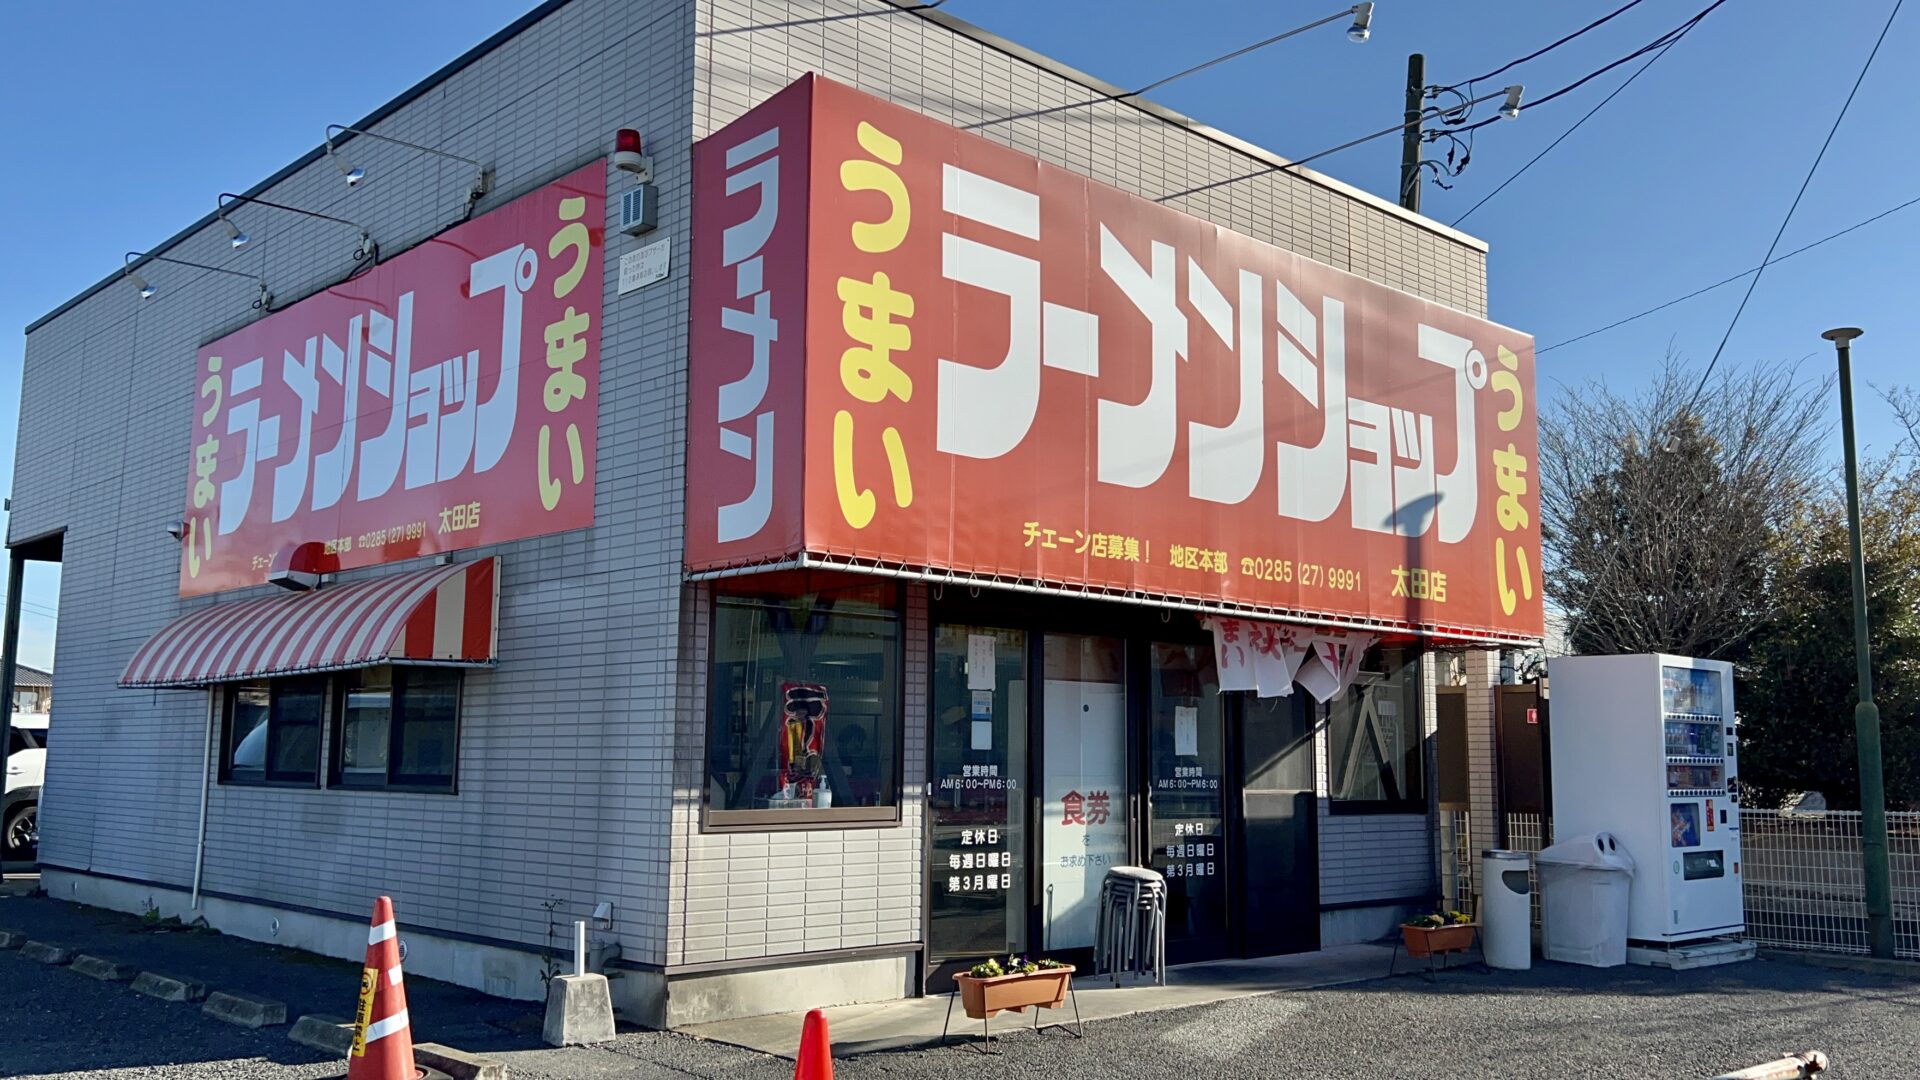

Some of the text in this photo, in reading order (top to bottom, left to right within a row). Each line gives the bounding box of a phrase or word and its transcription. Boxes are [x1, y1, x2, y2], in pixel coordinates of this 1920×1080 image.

[717, 126, 779, 543] ラーメン
[833, 120, 915, 529] うまい
[537, 196, 591, 511] うまい
[936, 162, 1488, 544] ラーメンショップ
[218, 242, 539, 536] ラーメンショップ
[187, 356, 223, 579] うまい
[1491, 344, 1532, 616] うまい
[438, 501, 480, 534] 太田店
[1023, 521, 1150, 564] チェーン店募集！
[1169, 544, 1228, 575] 地区本部
[1391, 564, 1447, 603] 太田店
[962, 765, 998, 777] 営業時間
[1174, 767, 1203, 778] 営業時間
[1061, 790, 1111, 826] 食券
[961, 829, 998, 845] 定休日
[1174, 823, 1204, 837] 定休日
[949, 852, 1011, 870] 毎週日曜日
[1060, 854, 1112, 868] お求め下さい
[1166, 843, 1215, 858] 毎週日曜日
[949, 874, 1011, 892] 第3月曜日
[1166, 862, 1215, 878] 第3月曜日
